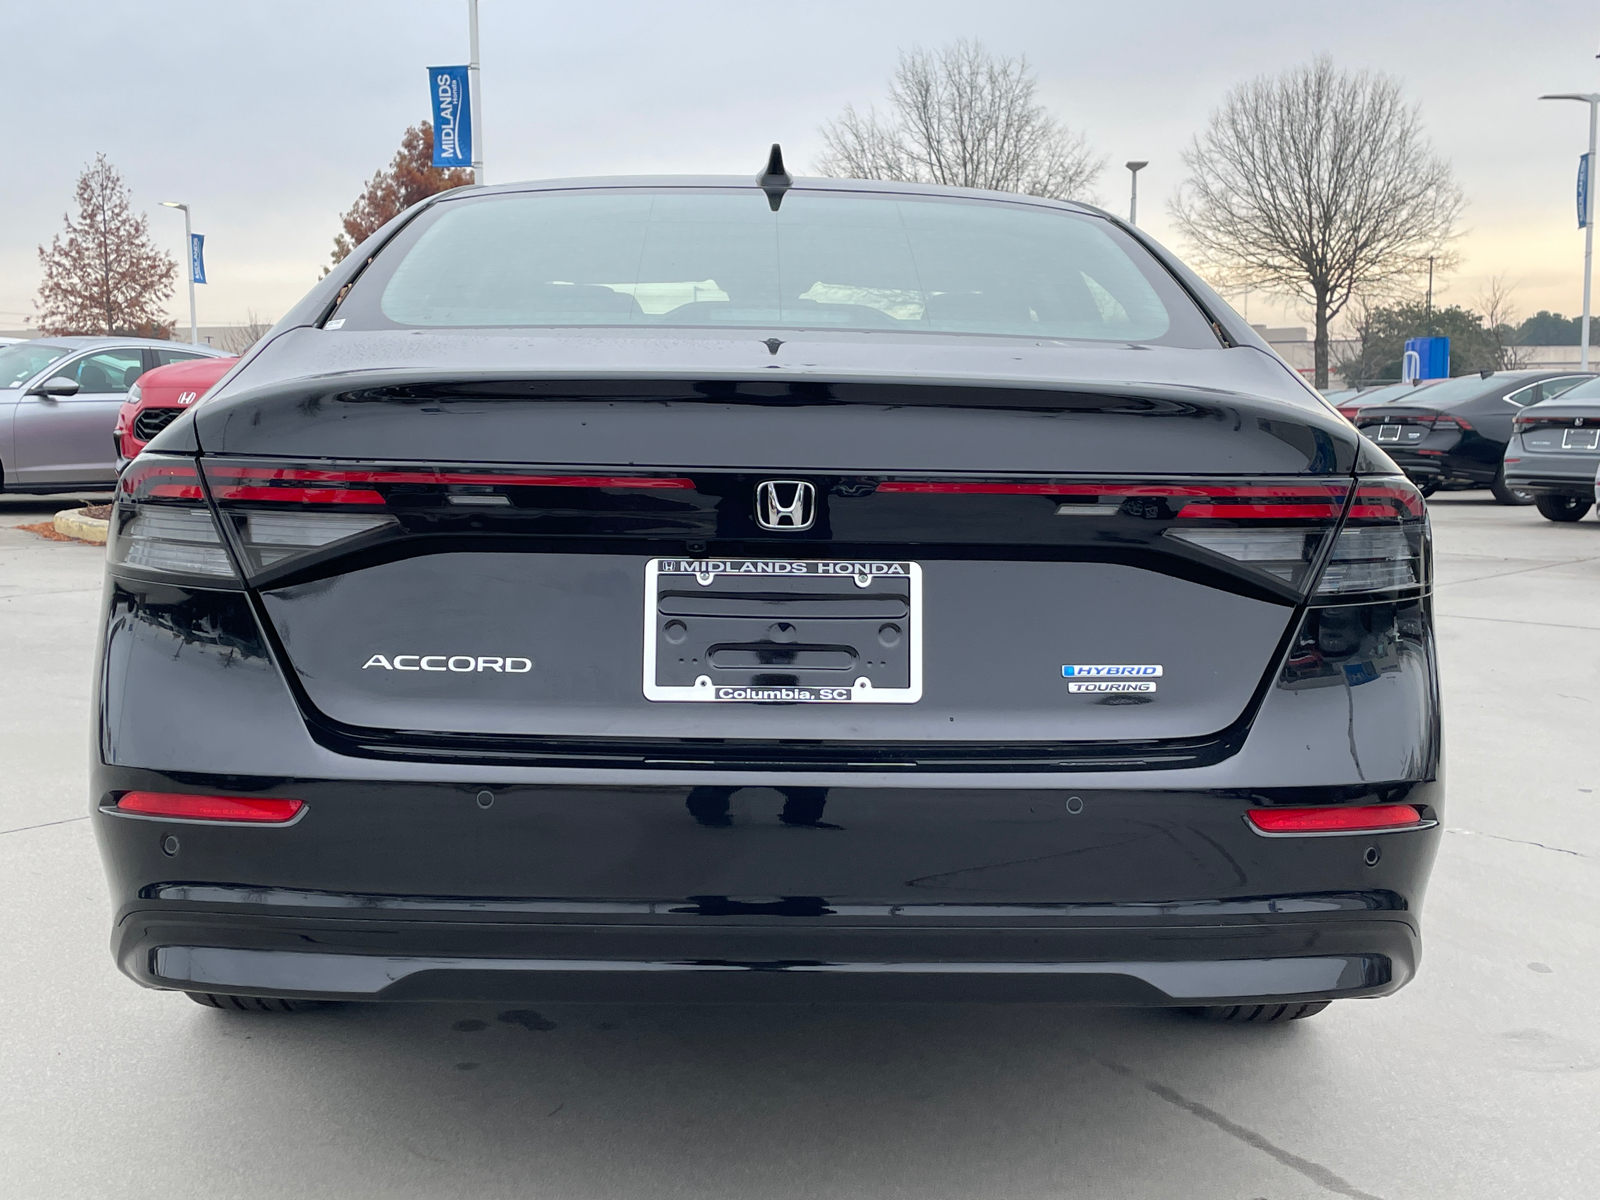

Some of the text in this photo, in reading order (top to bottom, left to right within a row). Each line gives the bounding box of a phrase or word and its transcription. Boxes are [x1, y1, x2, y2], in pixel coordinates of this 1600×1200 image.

[437, 74, 455, 158] MIDLANDS
[680, 561, 905, 574] MIDLANDS HONDA
[362, 654, 533, 673] ACCORD
[1077, 667, 1156, 675] HYBRID
[719, 688, 848, 700] Columbia, SC
[1074, 684, 1150, 692] TOURING
